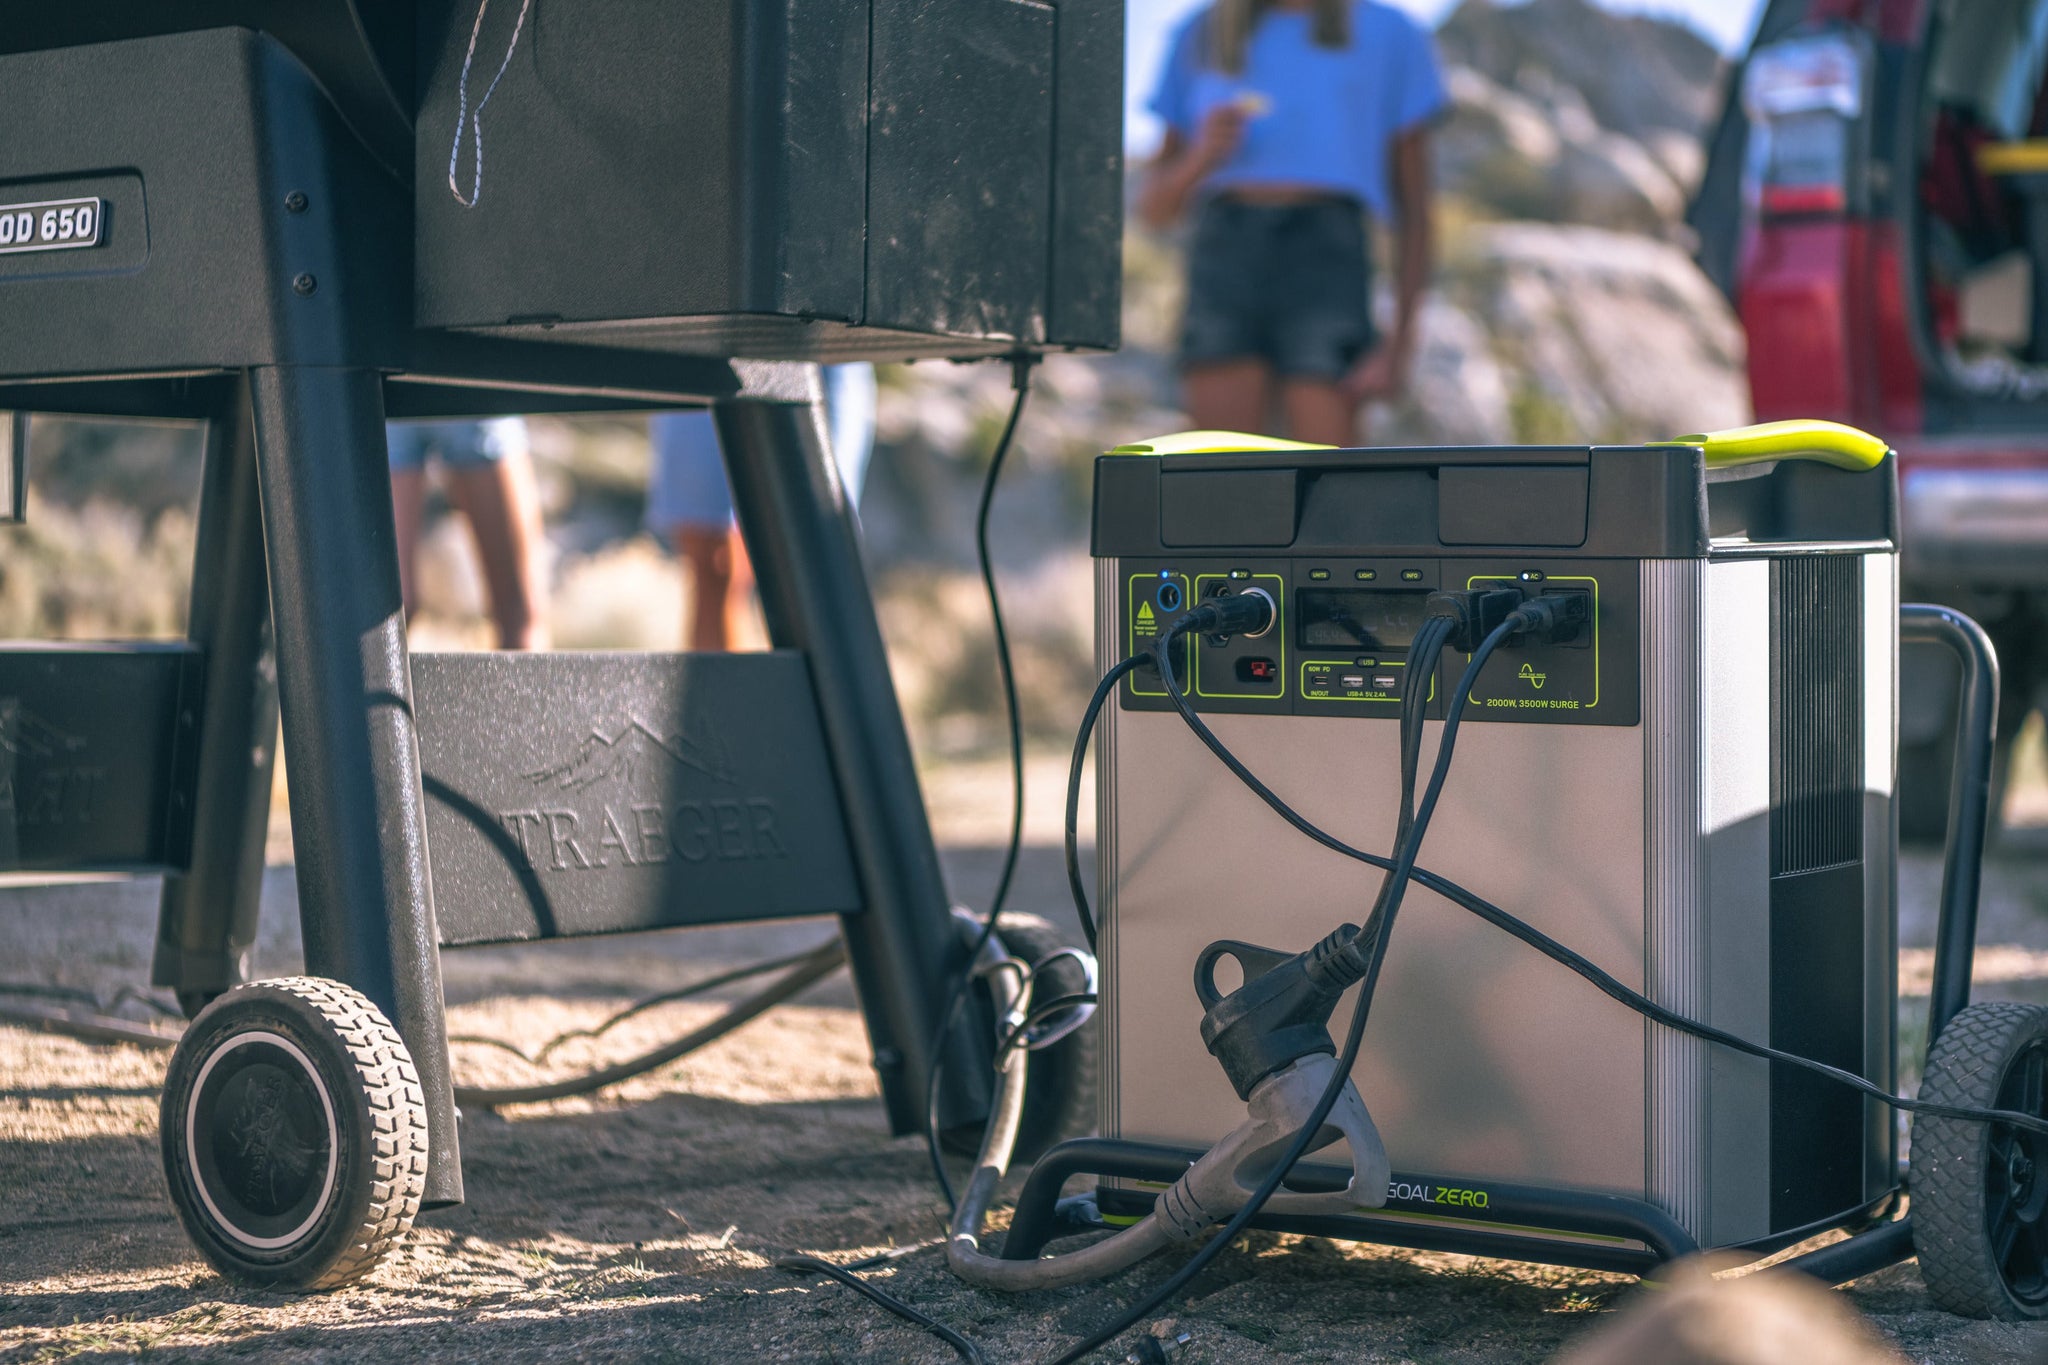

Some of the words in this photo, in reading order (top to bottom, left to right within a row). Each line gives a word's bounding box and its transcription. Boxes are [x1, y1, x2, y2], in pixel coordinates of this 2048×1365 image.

[41, 206, 93, 241] 650
[1487, 698, 1517, 708] 2000W,
[1519, 699, 1548, 709] 3500W
[1550, 700, 1579, 709] SURGE
[500, 798, 788, 872] TRAEGER
